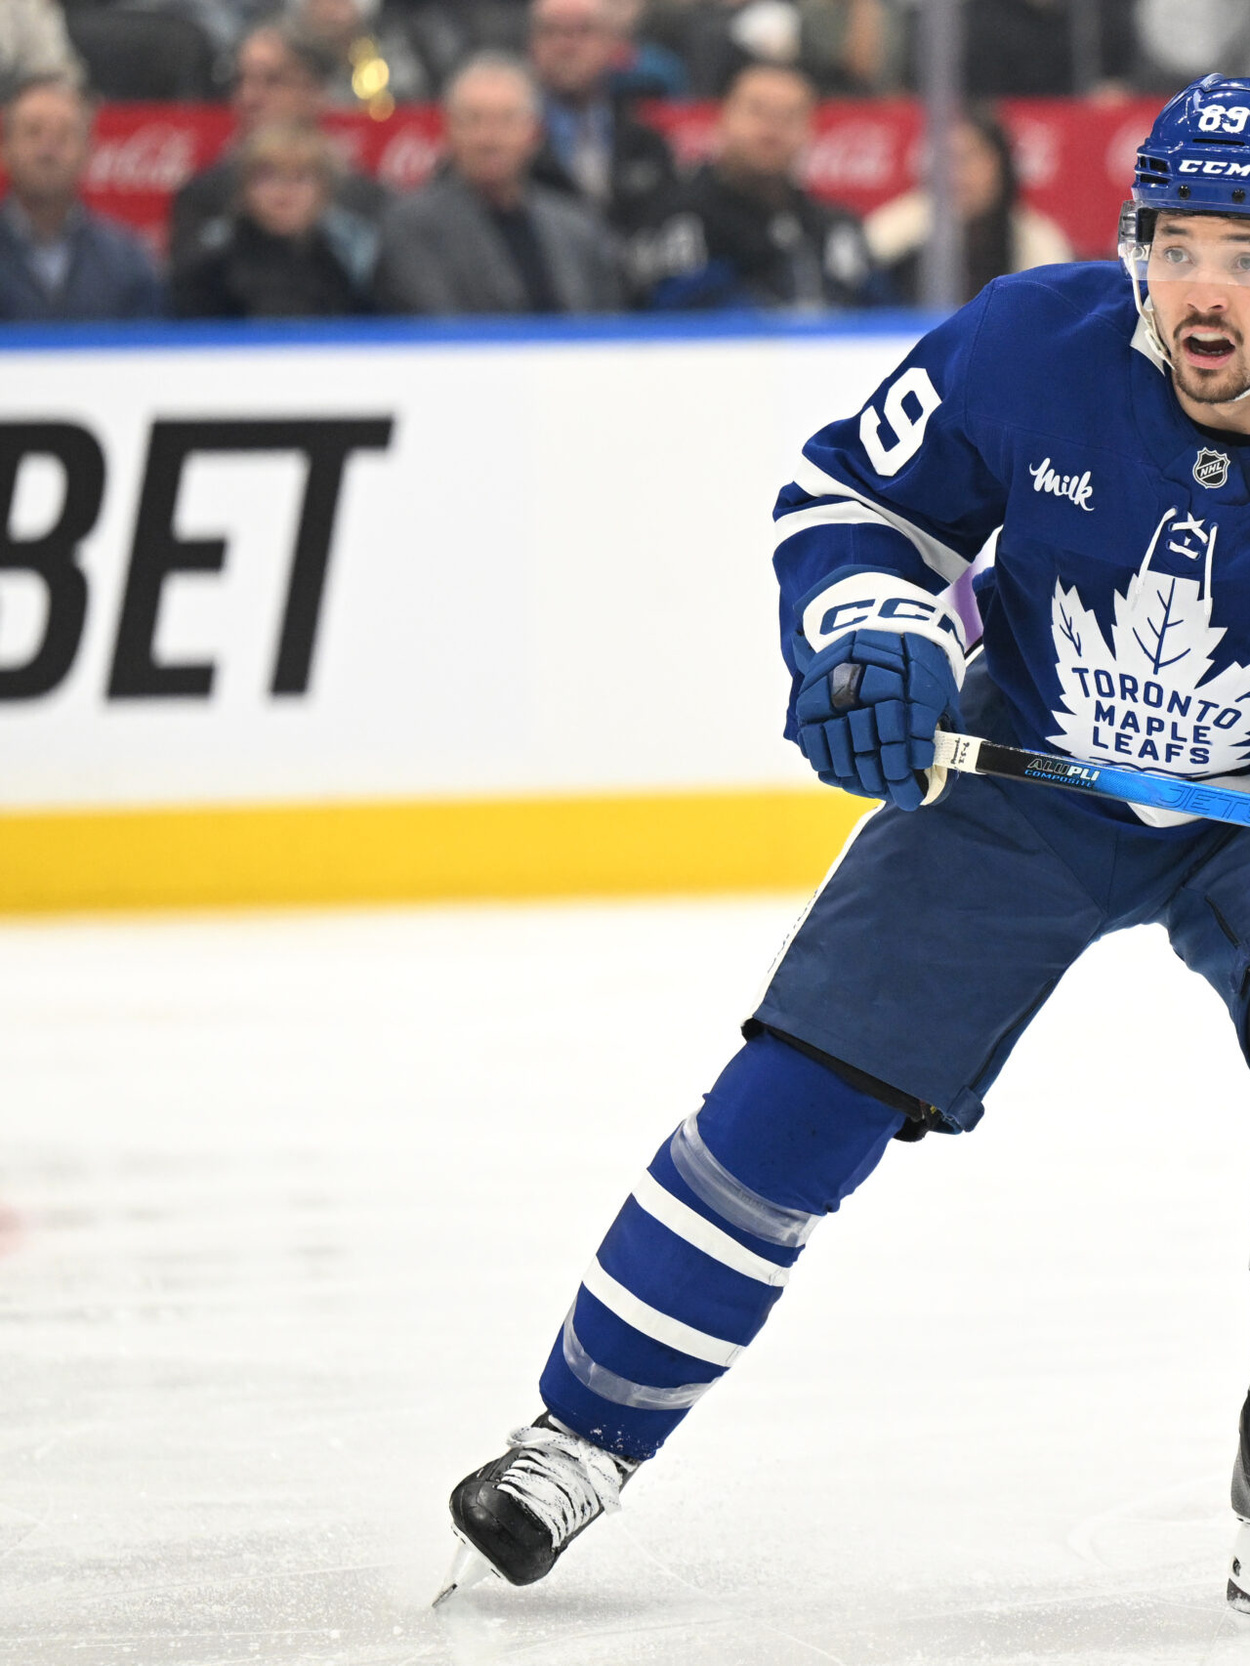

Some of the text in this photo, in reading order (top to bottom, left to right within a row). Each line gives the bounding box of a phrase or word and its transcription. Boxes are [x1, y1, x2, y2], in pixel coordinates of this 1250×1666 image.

[1198, 104, 1250, 133] 89
[1029, 457, 1095, 511] Milk
[1200, 461, 1223, 478] NHL
[0, 415, 395, 703] BET
[1071, 667, 1242, 729] TORONTO
[1094, 700, 1213, 746] MAPLE
[1093, 725, 1210, 765] LEAFS
[1024, 769, 1096, 788] COMPOSITE
[1027, 758, 1100, 781] ALUPLI
